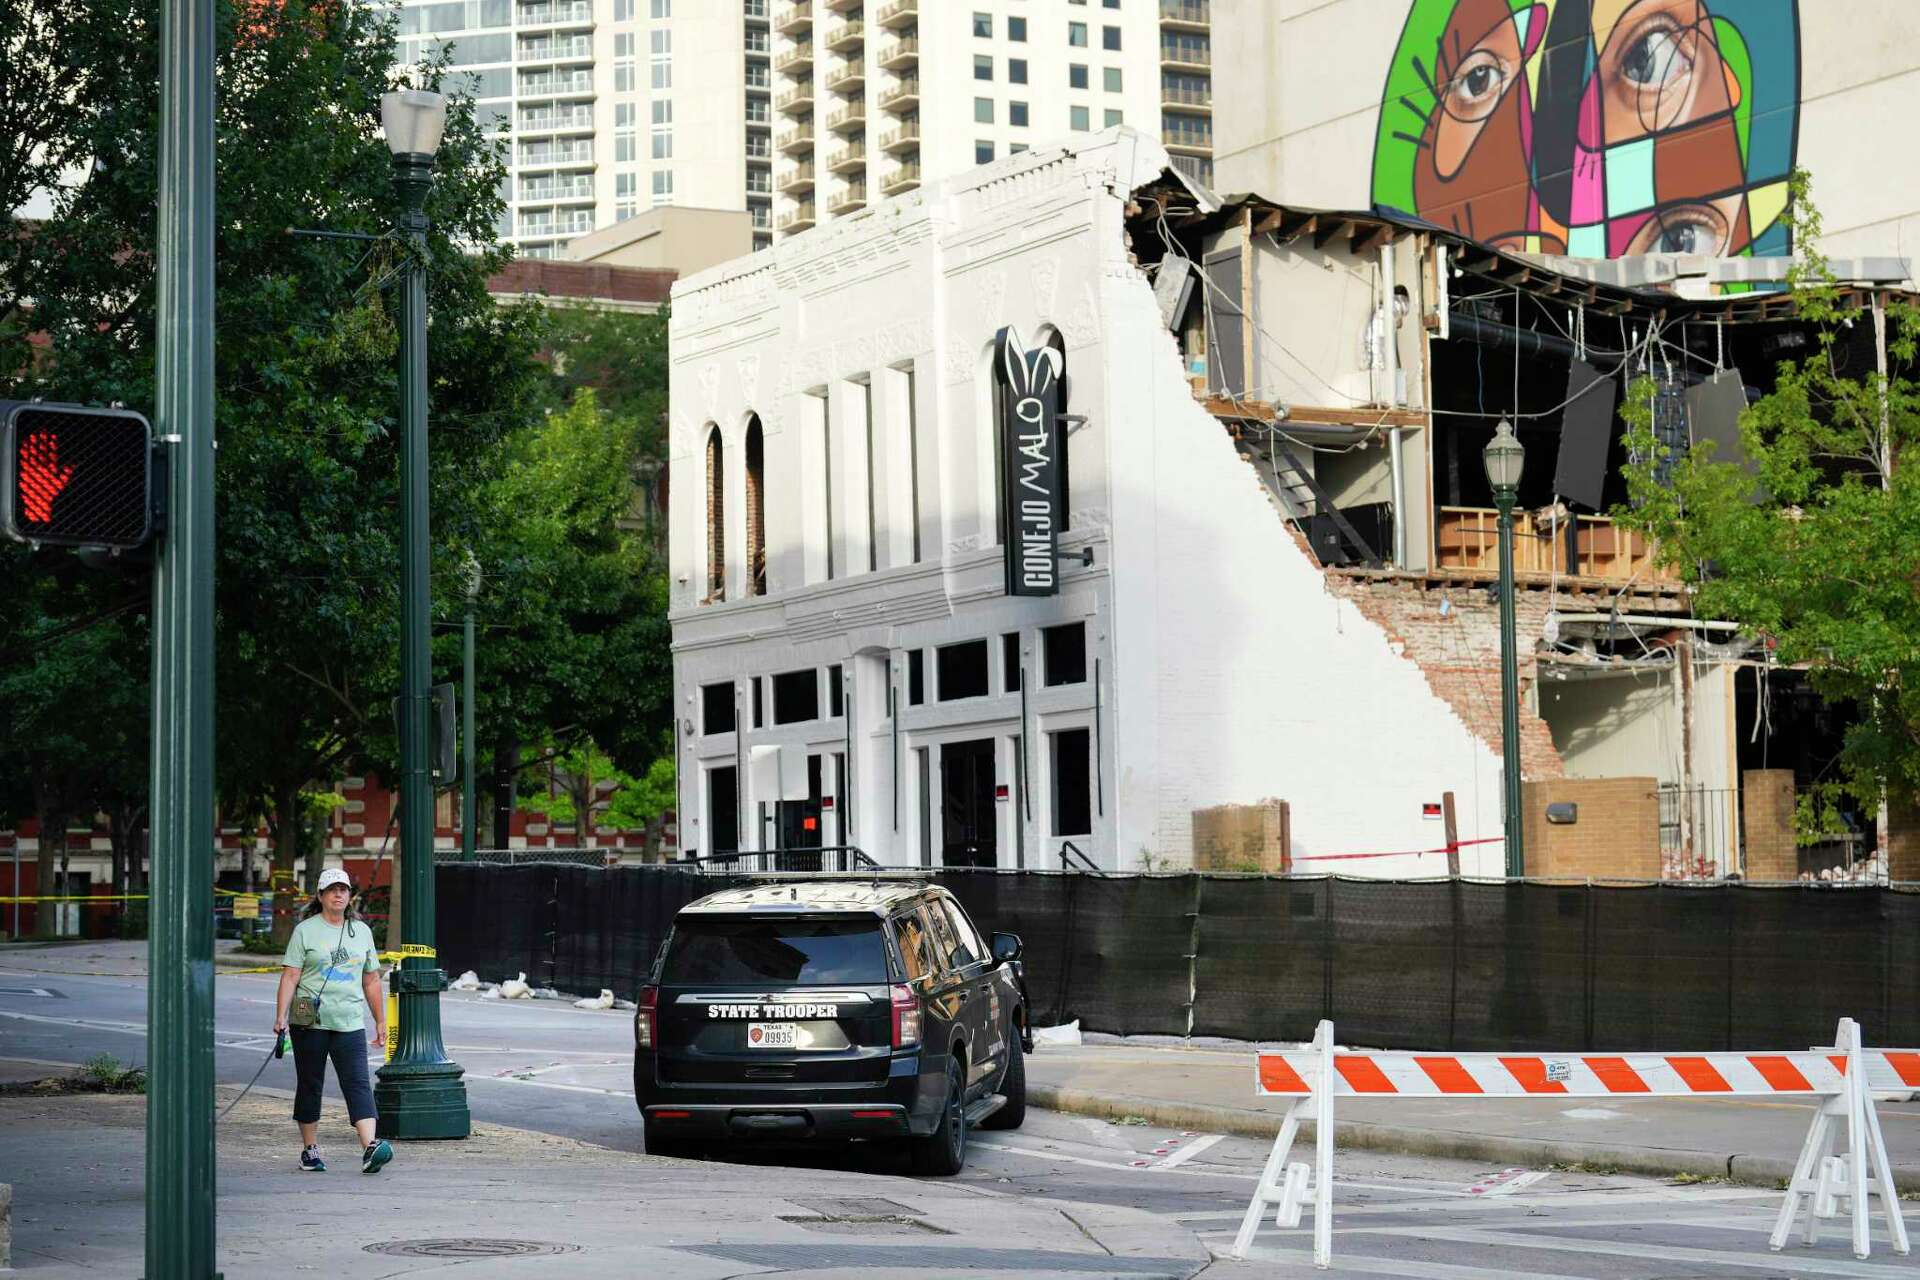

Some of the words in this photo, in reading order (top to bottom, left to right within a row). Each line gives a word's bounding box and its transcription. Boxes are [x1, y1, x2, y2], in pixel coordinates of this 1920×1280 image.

[1016, 397, 1050, 495] MALO
[1022, 500, 1053, 588] CONEJO
[708, 1004, 760, 1018] STATE
[763, 1004, 838, 1018] TROOPER
[388, 1026, 399, 1045] CROSS
[765, 1031, 792, 1043] 09935
